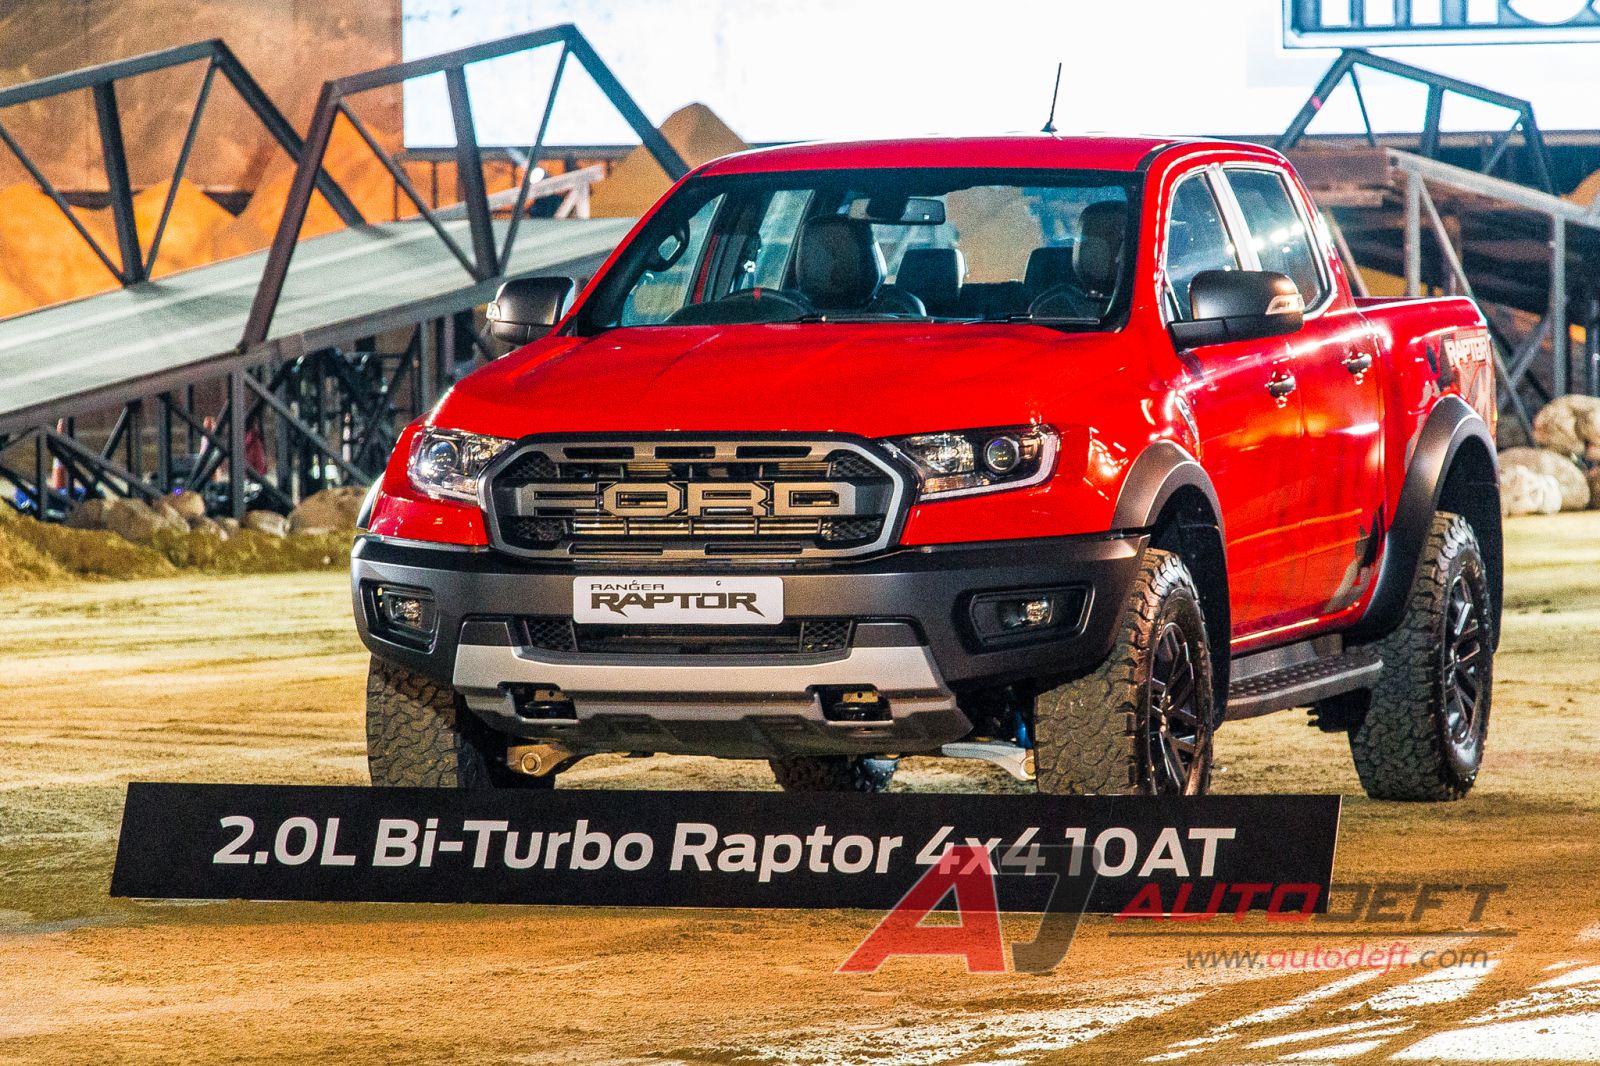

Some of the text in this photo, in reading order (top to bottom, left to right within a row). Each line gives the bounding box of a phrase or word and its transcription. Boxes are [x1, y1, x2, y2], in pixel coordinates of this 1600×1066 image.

[521, 481, 857, 517] FORD
[590, 583, 665, 591] RANGER
[590, 592, 767, 618] RAPTOR
[212, 814, 1237, 882] 2.0L Bi-Turbo Raptor 4x4 10AT
